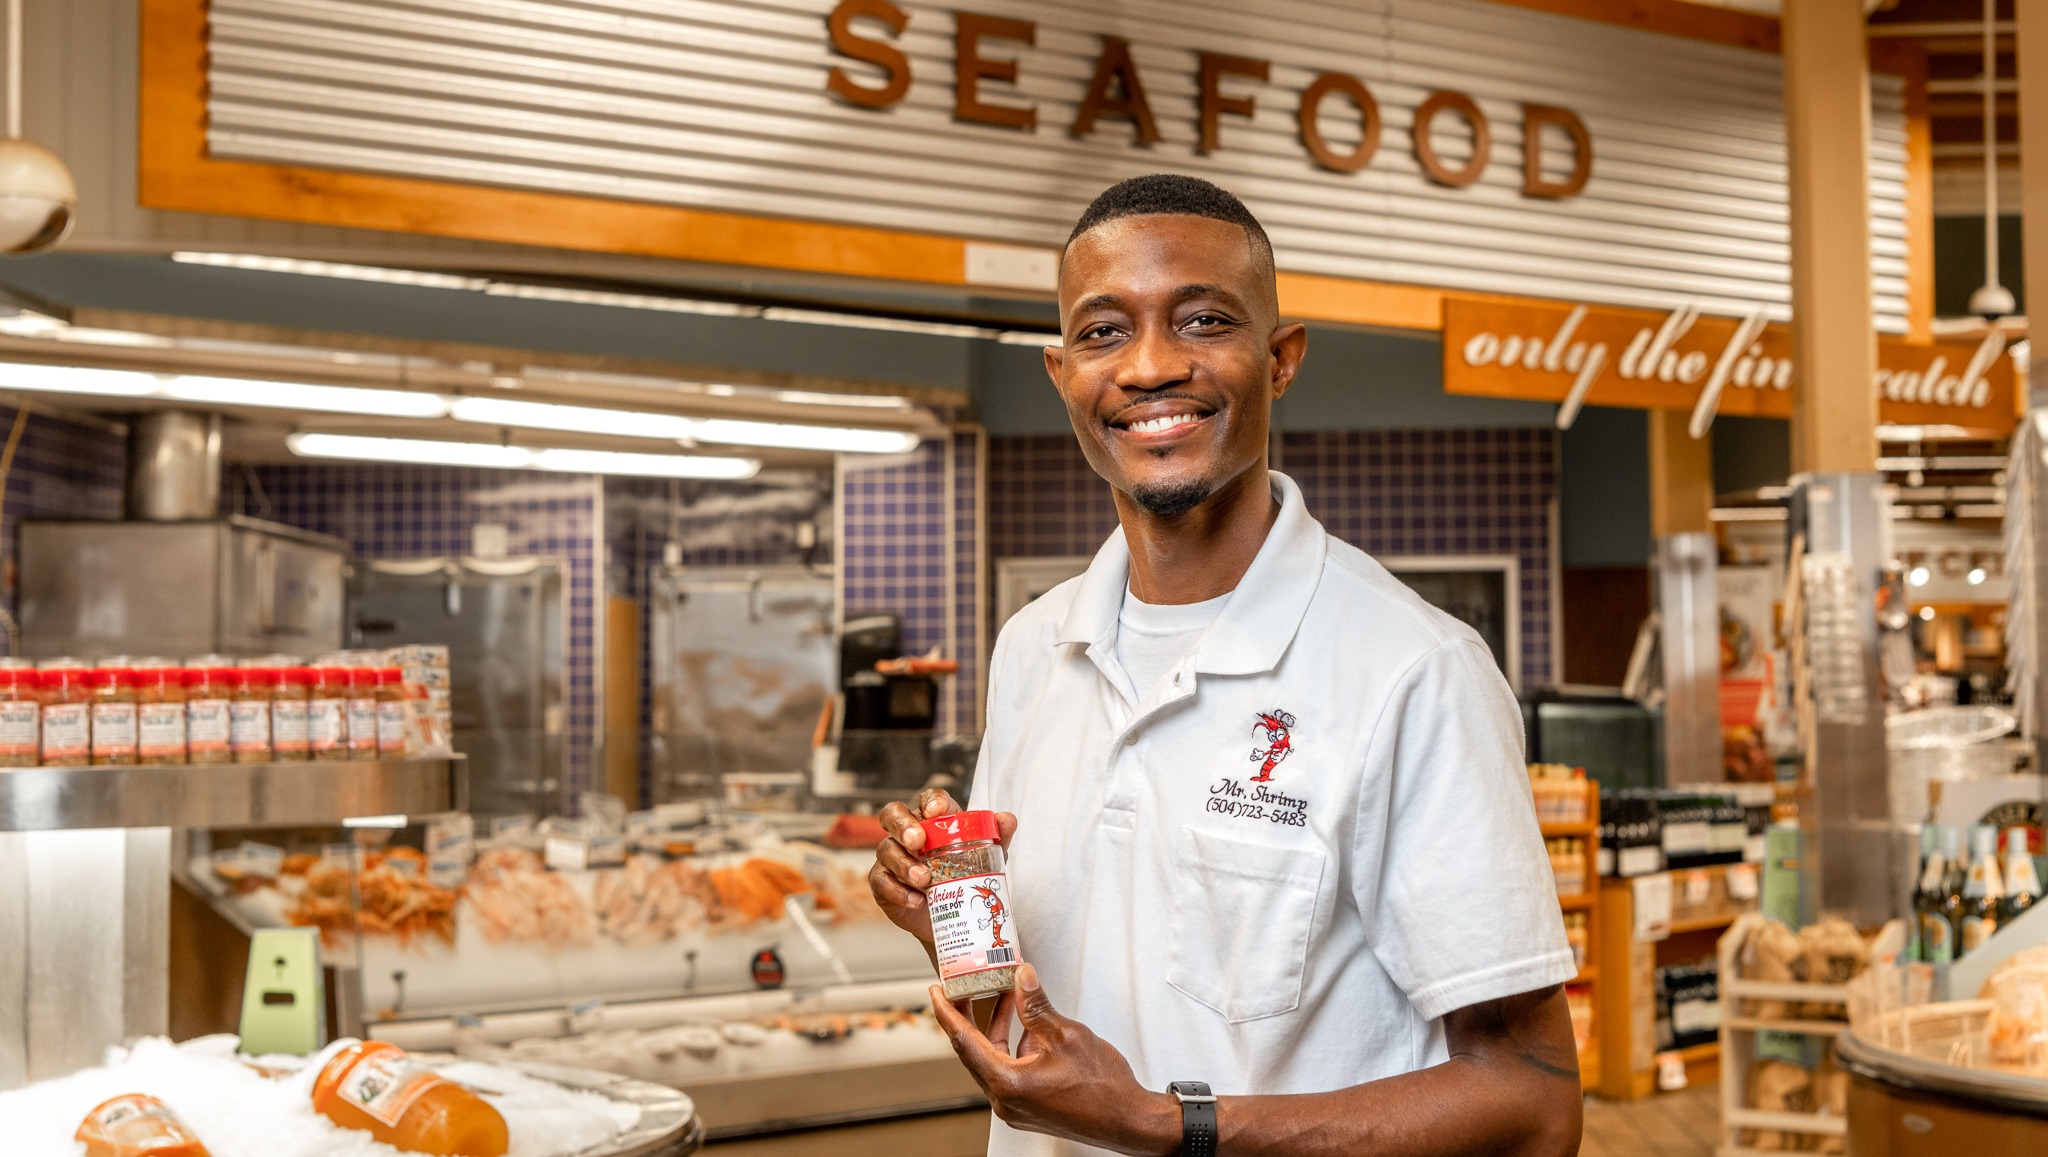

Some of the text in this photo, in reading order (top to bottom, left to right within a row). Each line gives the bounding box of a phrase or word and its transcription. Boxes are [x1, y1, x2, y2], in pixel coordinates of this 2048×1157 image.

[826, 0, 1593, 199] SEAFOOD
[1463, 304, 1608, 430] only
[1618, 300, 1708, 384] the
[1688, 302, 1793, 439] fin
[1206, 797, 1308, 827] (504)723-5483
[1210, 778, 1308, 814] Mr. Shrimp
[928, 886, 964, 906] Shrimp
[948, 922, 955, 930] to
[956, 920, 968, 928] any
